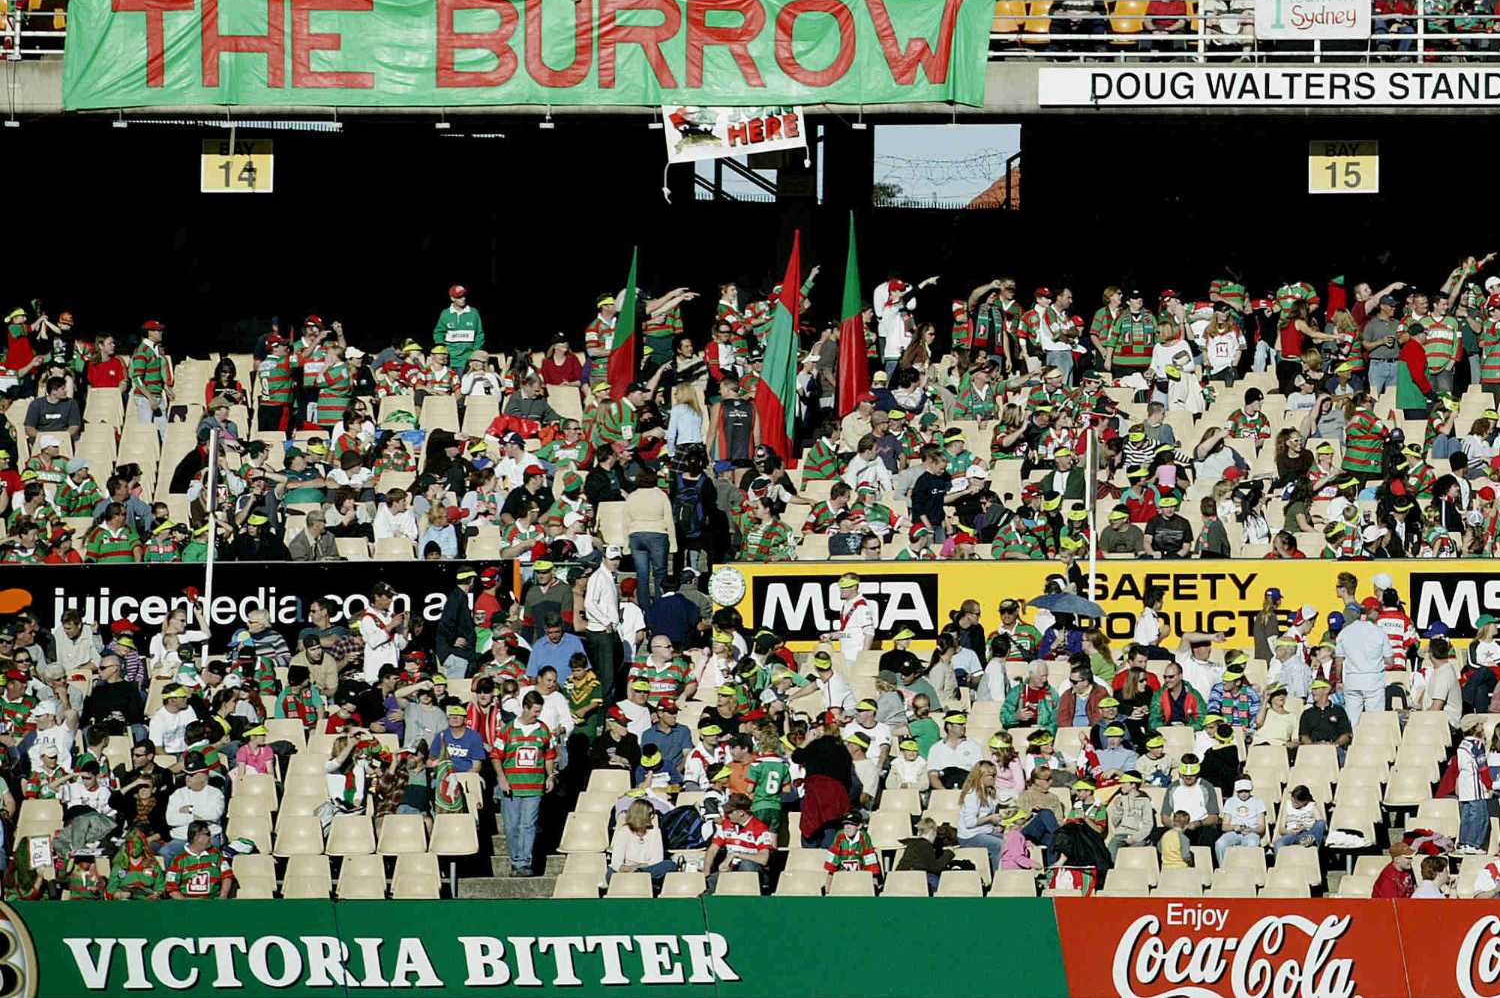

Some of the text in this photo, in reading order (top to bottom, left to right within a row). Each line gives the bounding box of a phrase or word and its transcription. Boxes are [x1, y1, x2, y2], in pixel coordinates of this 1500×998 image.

[1291, 5, 1356, 30] Sydney
[1091, 72, 1195, 100] DOUG
[1206, 71, 1377, 100] WALTERS
[727, 112, 800, 147] HERE
[219, 142, 256, 156] BAY
[1324, 142, 1359, 156] BAY
[218, 160, 257, 188] 14
[1325, 161, 1361, 188] 15
[1081, 573, 1257, 601] SAFETY
[762, 582, 934, 631] MSA
[766, 771, 779, 794] 6
[1167, 903, 1229, 931] Enjoy
[63, 936, 444, 989] VICTORIA
[458, 932, 741, 987] BITTER
